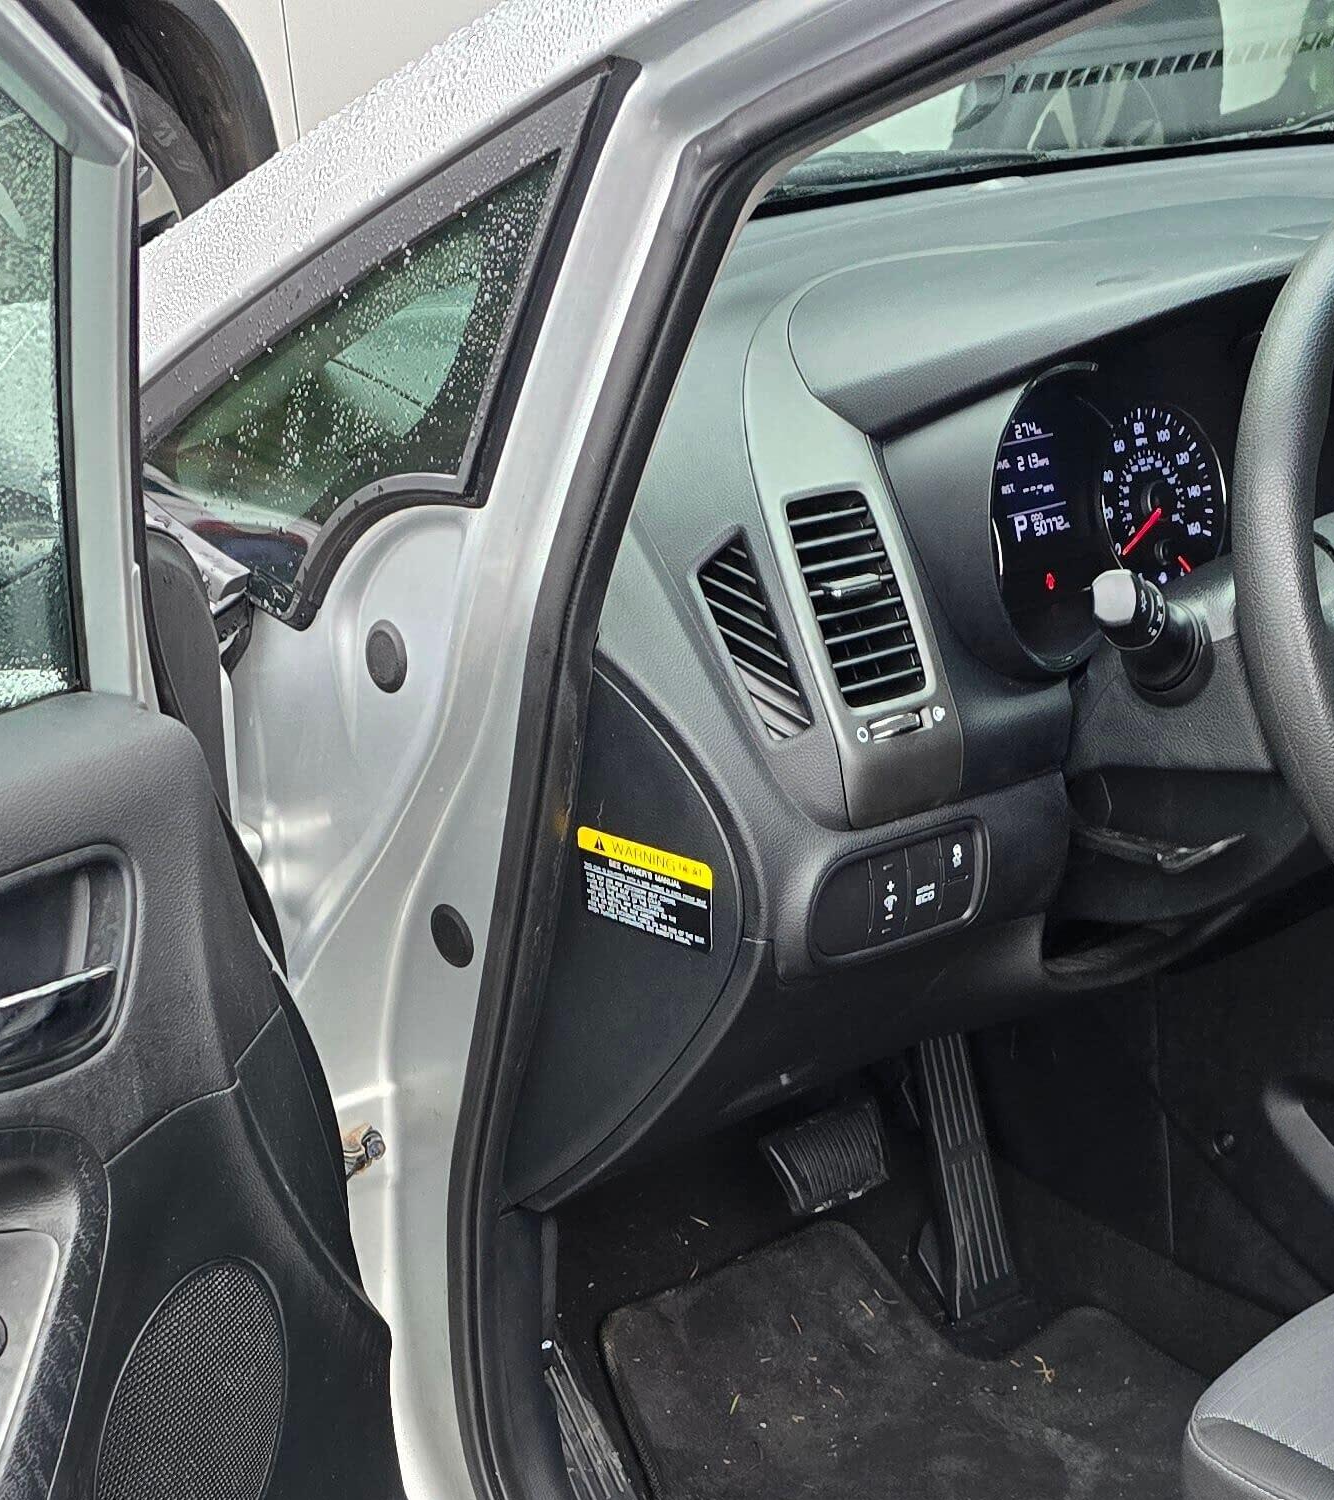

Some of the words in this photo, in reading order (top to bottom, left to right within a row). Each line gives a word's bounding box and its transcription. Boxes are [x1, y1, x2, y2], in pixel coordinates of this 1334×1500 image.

[1156, 429, 1171, 442] 100
[1175, 451, 1189, 465] 120
[1014, 515, 1027, 542] P
[611, 841, 676, 872] WARNING
